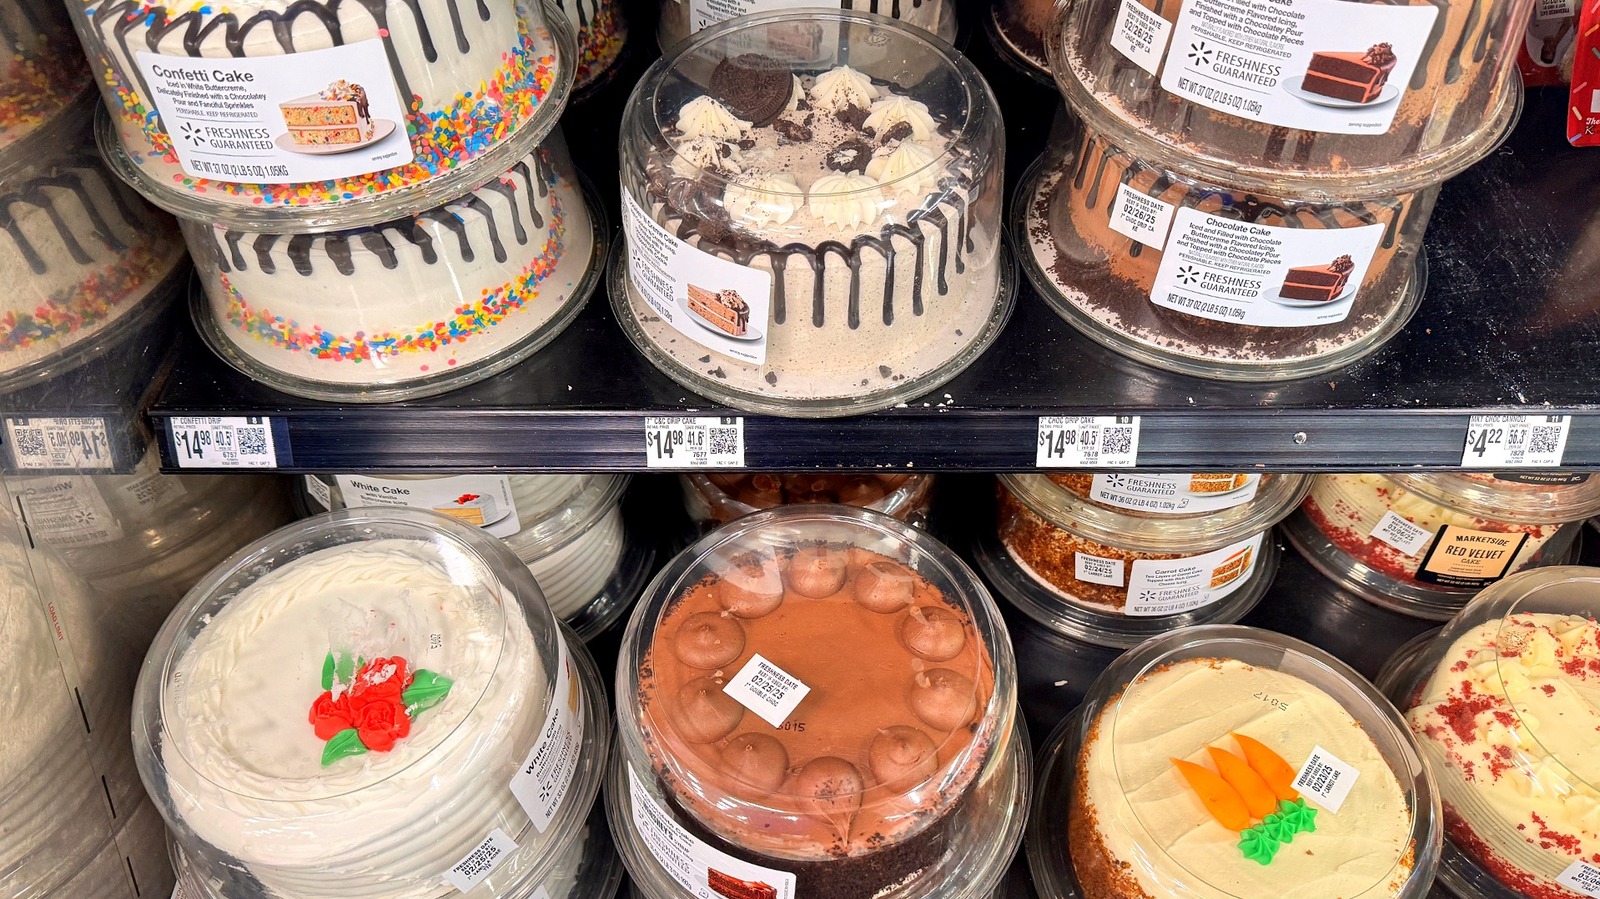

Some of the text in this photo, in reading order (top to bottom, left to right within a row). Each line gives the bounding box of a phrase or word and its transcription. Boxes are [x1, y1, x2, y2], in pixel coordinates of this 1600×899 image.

[1195, 1, 1222, 16] Finished
[1223, 10, 1238, 21] with
[1244, 18, 1284, 34] Chocolatey
[1285, 28, 1303, 37] Pour
[1246, 9, 1278, 22] Flavored
[1278, 18, 1298, 28] Icing,
[1252, 2, 1305, 20] with Chocolate
[1125, 19, 1153, 44] 02/26/25
[1149, 18, 1161, 29] DATE
[1189, 8, 1304, 46] and Topped with Chocolate Pieces
[1244, 42, 1292, 58] REFRIGERATED
[1216, 51, 1282, 77] FRESHNESS
[152, 64, 254, 82] Confetti Cake
[1212, 63, 1277, 87] GUARANTEED
[156, 86, 183, 98] Delicately
[184, 91, 209, 99] Finished
[210, 92, 224, 100] with
[229, 93, 267, 101] Chocolatey
[166, 80, 247, 92] Iced in White Buttercreme,
[172, 97, 186, 105] Pour
[199, 100, 224, 108] Fanciful
[224, 102, 254, 110] Sprinkles
[204, 127, 270, 139] FRESHNESS
[210, 139, 274, 150] GUARANTEED
[190, 159, 203, 171] NET
[203, 162, 213, 172] WT
[212, 163, 220, 173] 37
[221, 164, 231, 175] OZ
[264, 165, 289, 176] 1.05KG
[1123, 189, 1164, 211] FRESHNESS DATE
[1124, 204, 1155, 224] 02/26/25
[1189, 222, 1204, 231] Iced
[1217, 229, 1234, 238] Filled
[1235, 234, 1249, 242] with
[1249, 236, 1282, 246] Chocolate
[1206, 217, 1271, 236] Chocolate Cake
[1182, 234, 1208, 245] Finished
[1209, 241, 1223, 249] with
[1229, 246, 1264, 257] Chocolatey
[1191, 230, 1276, 252] Buttercreme Flavored Icing,
[1177, 239, 1188, 247] and
[1190, 243, 1212, 254] Topped
[1227, 252, 1260, 262] Chocolate
[1260, 257, 1281, 265] Pieces
[1203, 272, 1262, 289] FRESHNESS
[1200, 281, 1258, 298] GUARANTEED
[350, 480, 410, 495] White Cake
[1126, 486, 1175, 495] GUARANTEED
[1128, 478, 1176, 489] FRESHNESS
[1456, 535, 1509, 547] MARKETSIDE
[1445, 545, 1505, 559] RED VELVET
[1158, 591, 1199, 601] GUARANTEED
[1159, 586, 1200, 596] FRESHNESS
[48, 602, 64, 641] LOAD LIMIT
[751, 675, 785, 700] 02/25/25
[784, 679, 798, 690] DATE
[526, 708, 559, 775] White Cake
[1310, 754, 1320, 765] DATE
[1312, 765, 1333, 792] 02/23/25
[1332, 770, 1341, 780] CAKE
[481, 837, 493, 849] DATE
[465, 846, 496, 875] 02/25/25
